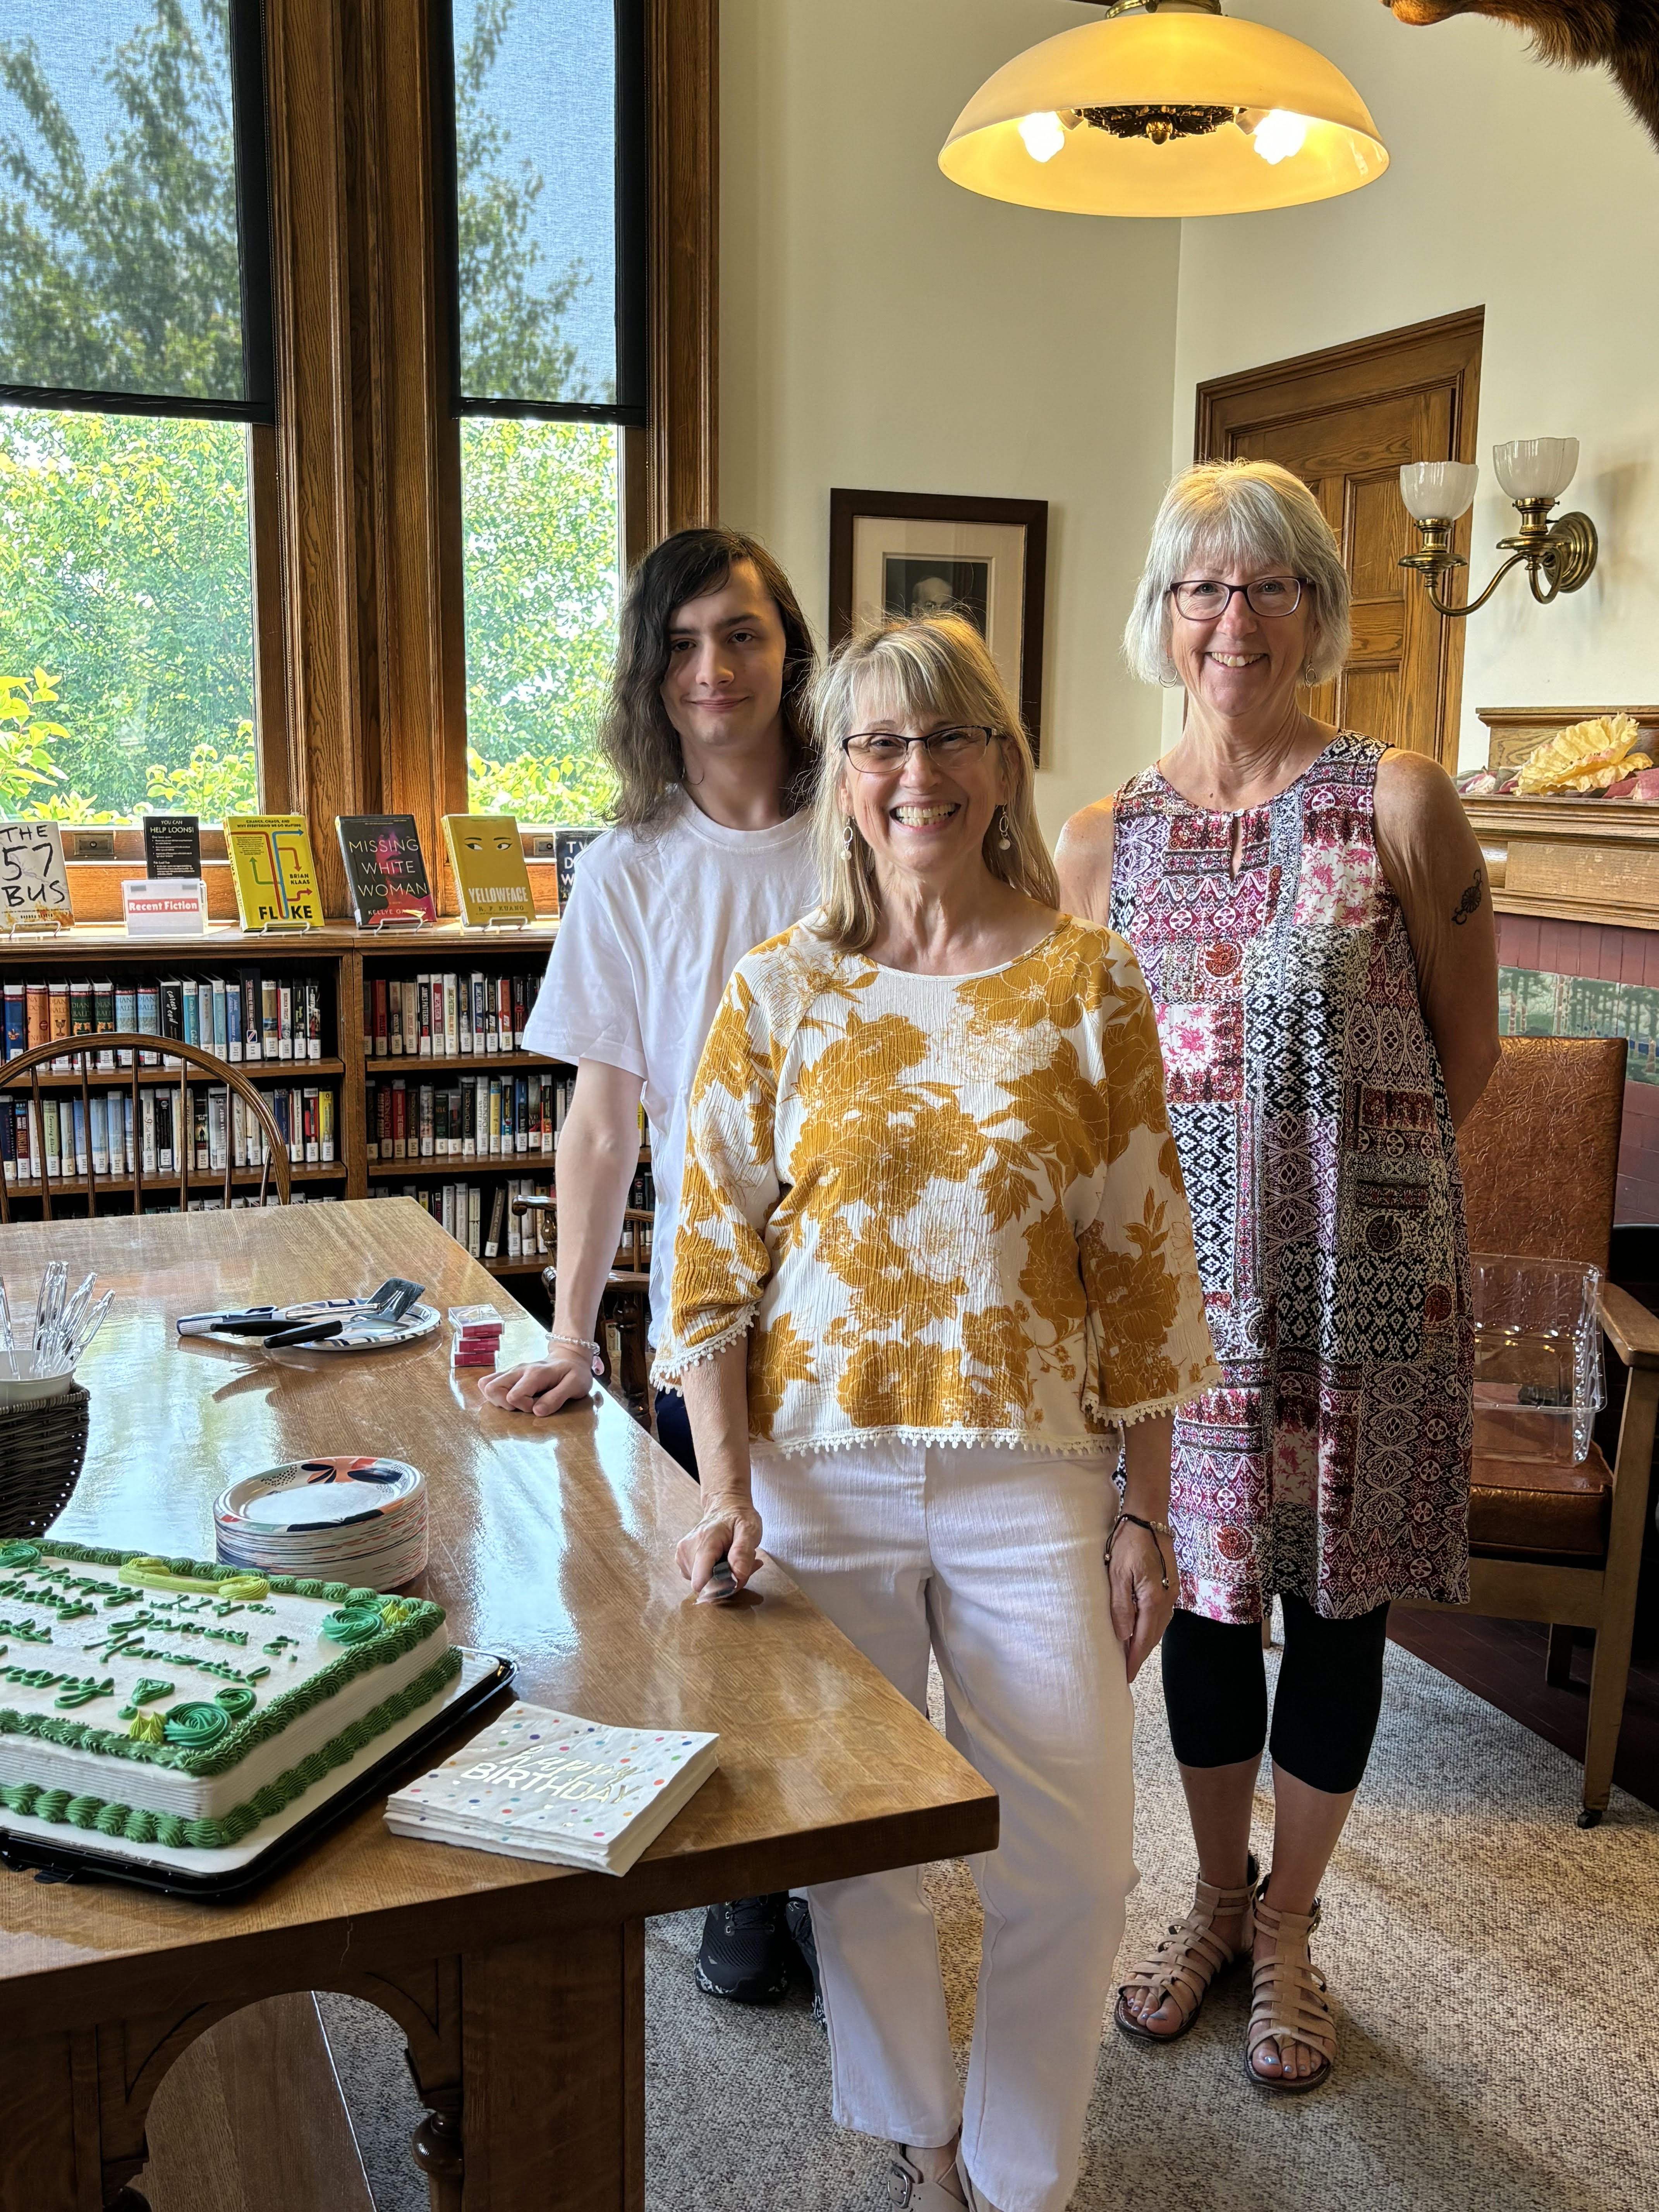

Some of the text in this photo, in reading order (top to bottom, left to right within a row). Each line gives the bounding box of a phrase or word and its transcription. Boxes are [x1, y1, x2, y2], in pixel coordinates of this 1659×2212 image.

[0, 825, 48, 842] THE
[349, 839, 419, 853] MISSING
[2, 842, 53, 881] 57
[361, 860, 415, 875] WHITE
[1, 880, 65, 907] BUS
[358, 883, 428, 896] WOMAN
[468, 887, 529, 903] YELLOWFACE
[129, 901, 198, 911] Recent Fiction
[167, 990, 178, 1010] career
[167, 1010, 179, 1024] evil
[13, 1565, 144, 1607] Happy
[0, 1580, 97, 1620] thday
[500, 1744, 646, 1787] happy
[460, 1762, 643, 1804] BIRTHDAY
